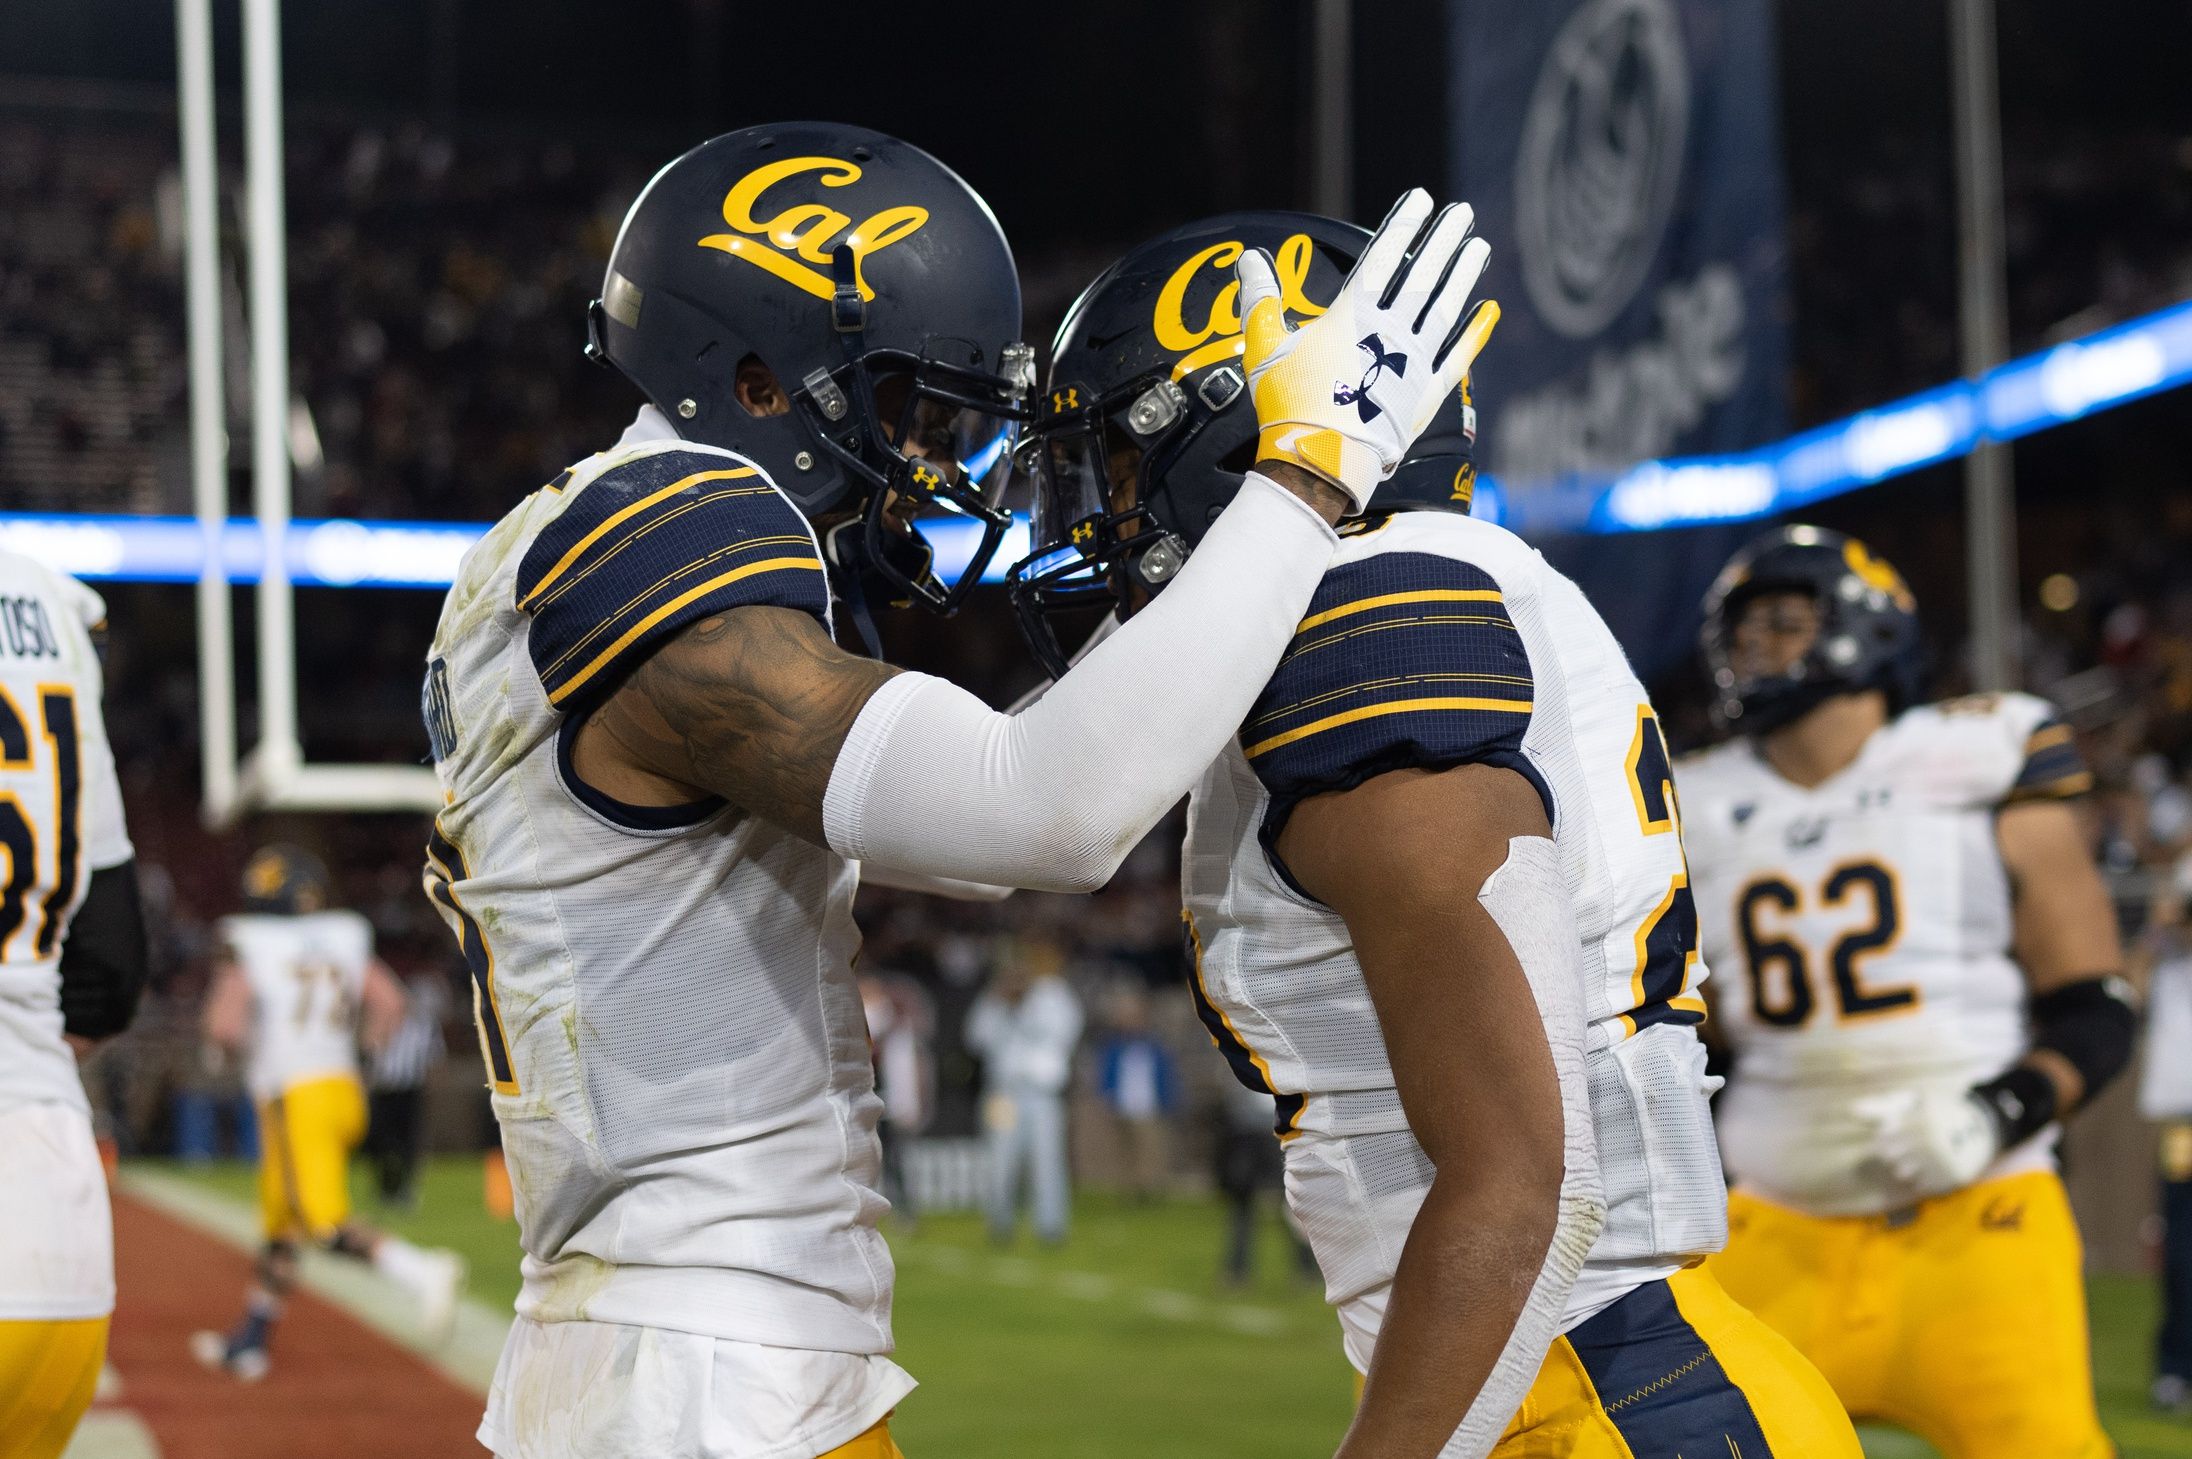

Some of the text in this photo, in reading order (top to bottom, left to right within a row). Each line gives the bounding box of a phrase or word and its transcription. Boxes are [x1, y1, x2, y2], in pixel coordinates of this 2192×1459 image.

[697, 156, 929, 303] Cal
[1153, 233, 1329, 384] Cal
[0, 597, 59, 657] OSO
[1733, 857, 1924, 1032] 62
